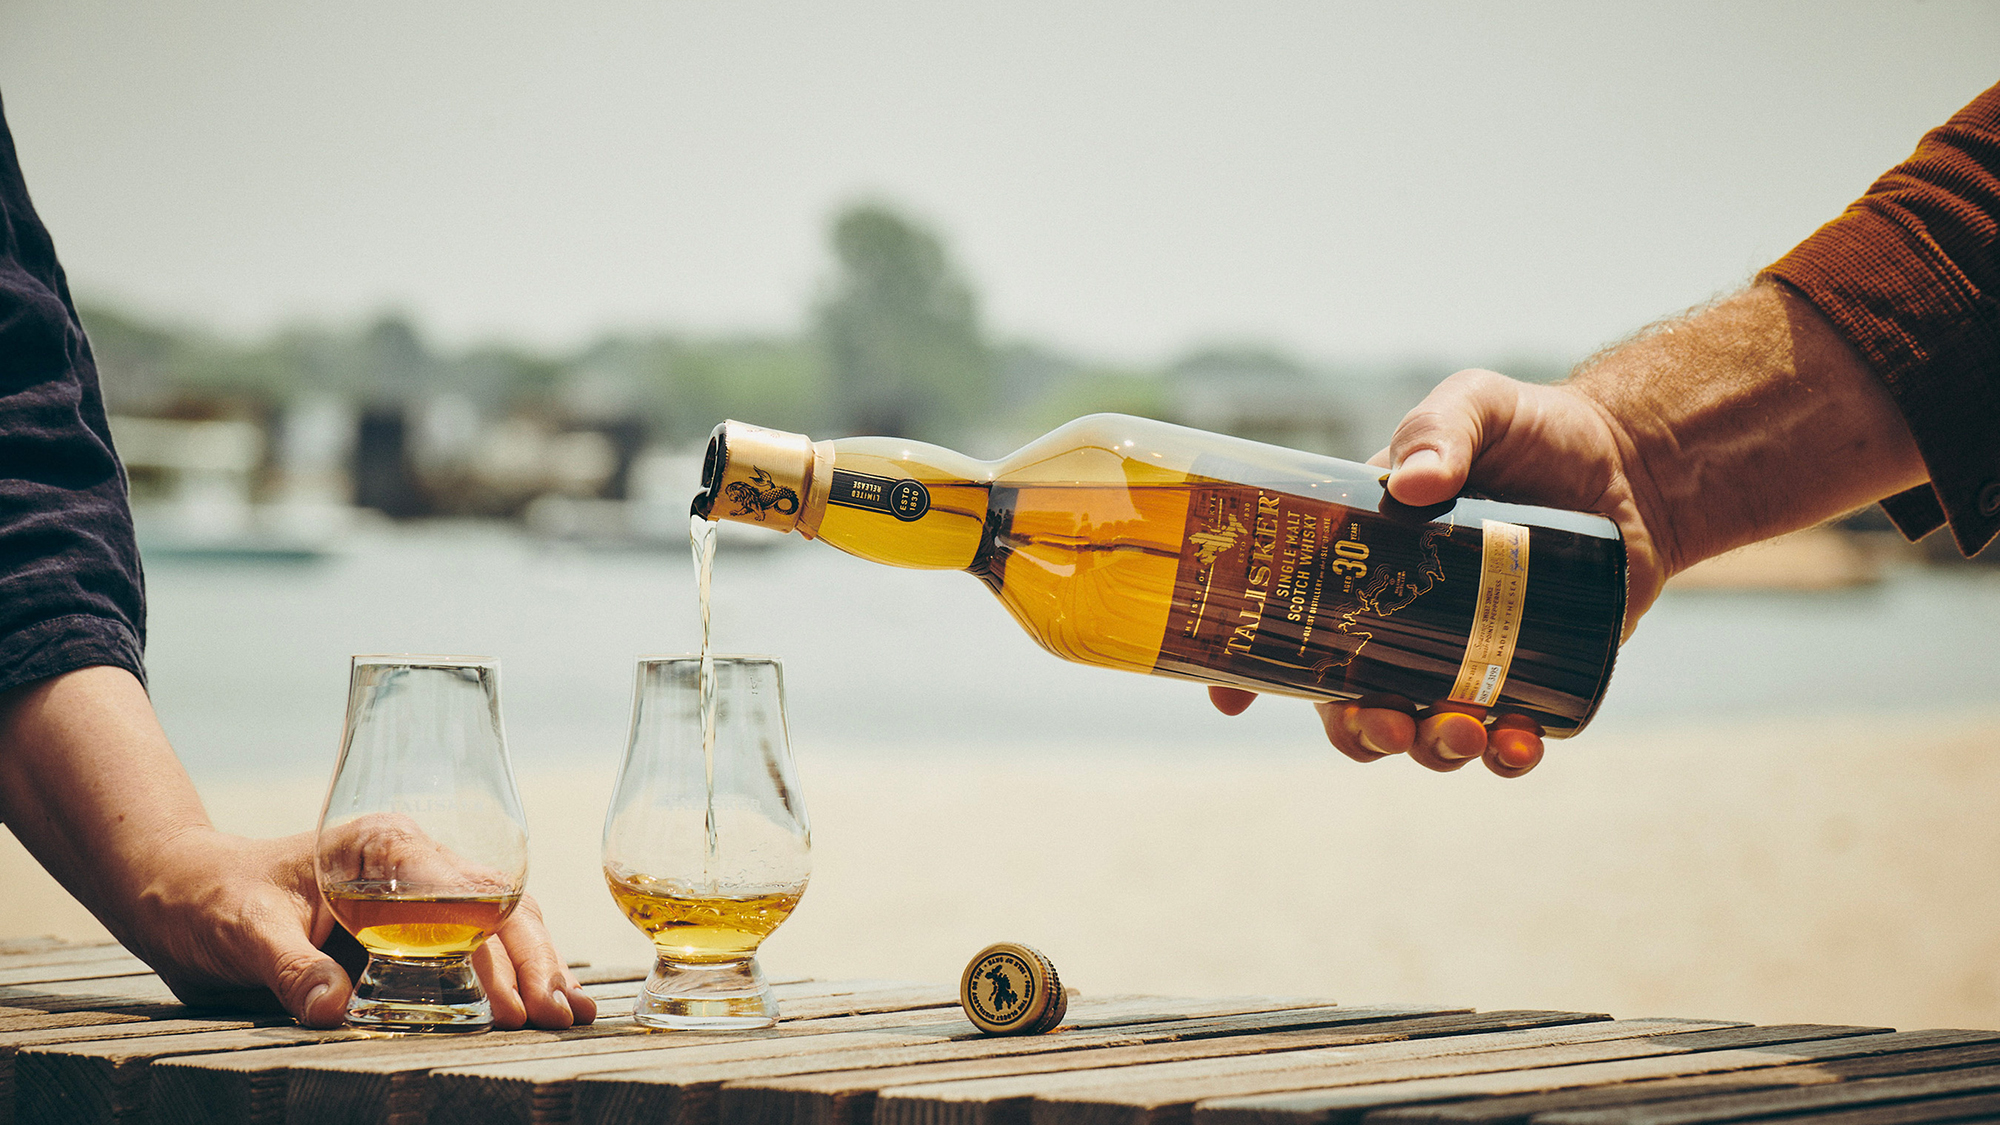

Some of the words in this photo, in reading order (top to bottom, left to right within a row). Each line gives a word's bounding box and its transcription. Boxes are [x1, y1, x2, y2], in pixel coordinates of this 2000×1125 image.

[851, 489, 880, 502] LIMITED
[852, 480, 882, 493] RELEASE
[899, 486, 910, 511] ESTD
[909, 490, 919, 511] 1830
[1285, 510, 1300, 545] MALT
[1323, 517, 1331, 534] SKYE
[1350, 522, 1359, 540] YEARS
[1322, 535, 1329, 544] OF
[1190, 590, 1201, 614] ISLE
[1199, 568, 1206, 582] OF
[1208, 496, 1217, 523] SKYE
[1237, 540, 1247, 563] ESTD
[1321, 546, 1329, 560] ISLE
[1332, 539, 1370, 579] 30
[1224, 496, 1280, 656] TALISKER
[1276, 548, 1297, 597] SINGLE
[1287, 570, 1310, 621] SCOTCH
[1299, 513, 1317, 565] WHISKY
[1343, 575, 1352, 594] AGED
[1509, 580, 1517, 597] SEA
[1310, 579, 1323, 614] DISTILLERY
[1506, 600, 1514, 616] THE
[1303, 615, 1315, 637] OLDEST
[1485, 621, 1495, 643] POINTY
[1503, 620, 1511, 631] BY
[1496, 634, 1508, 657] MADE
